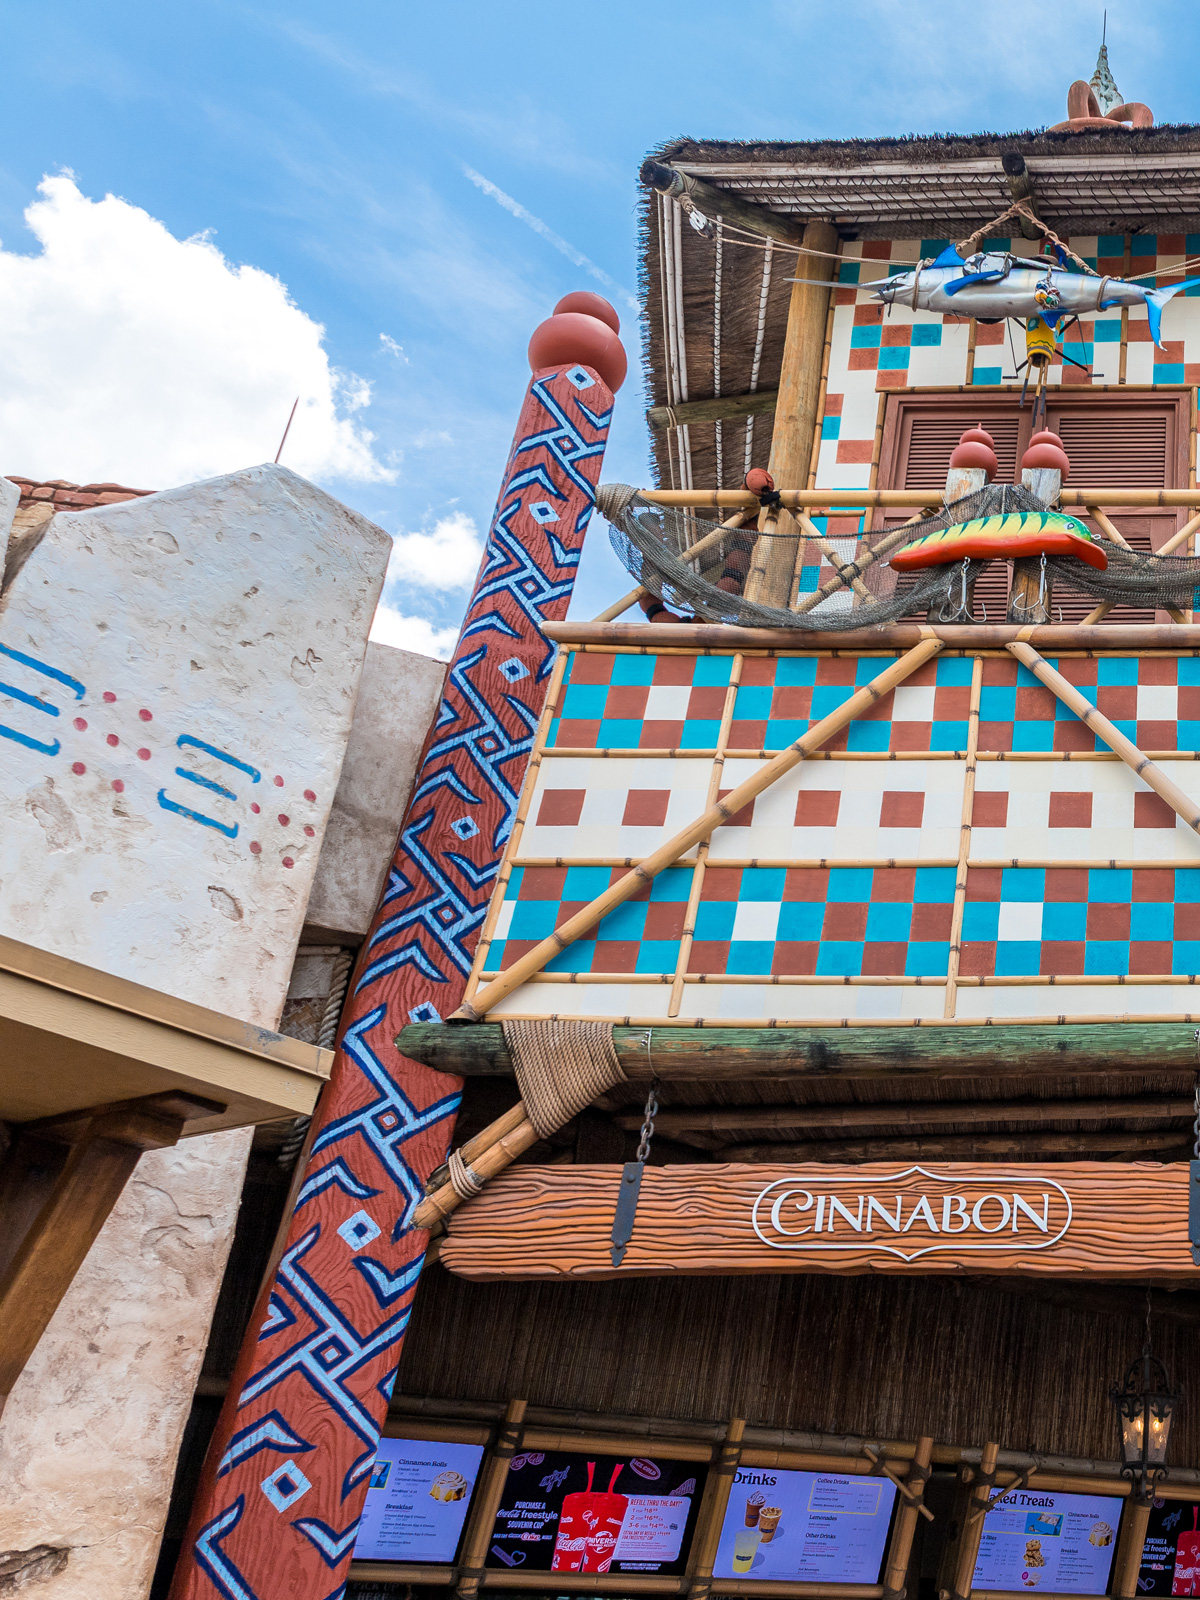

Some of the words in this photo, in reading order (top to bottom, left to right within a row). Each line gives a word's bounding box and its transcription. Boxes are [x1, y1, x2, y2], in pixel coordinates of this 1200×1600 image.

[771, 1190, 1049, 1236] CINNABON
[642, 1465, 657, 1476] COLD
[732, 1472, 777, 1486] Drinks
[515, 1501, 541, 1509] PURCHASE
[989, 1493, 1017, 1504] aed
[1020, 1494, 1055, 1507] Treats
[521, 1510, 558, 1522] freestyle
[1151, 1545, 1175, 1555] freestyle
[353, 1582, 379, 1590] PICK
[384, 1583, 399, 1591] UP
[357, 1592, 388, 1600] HERE
